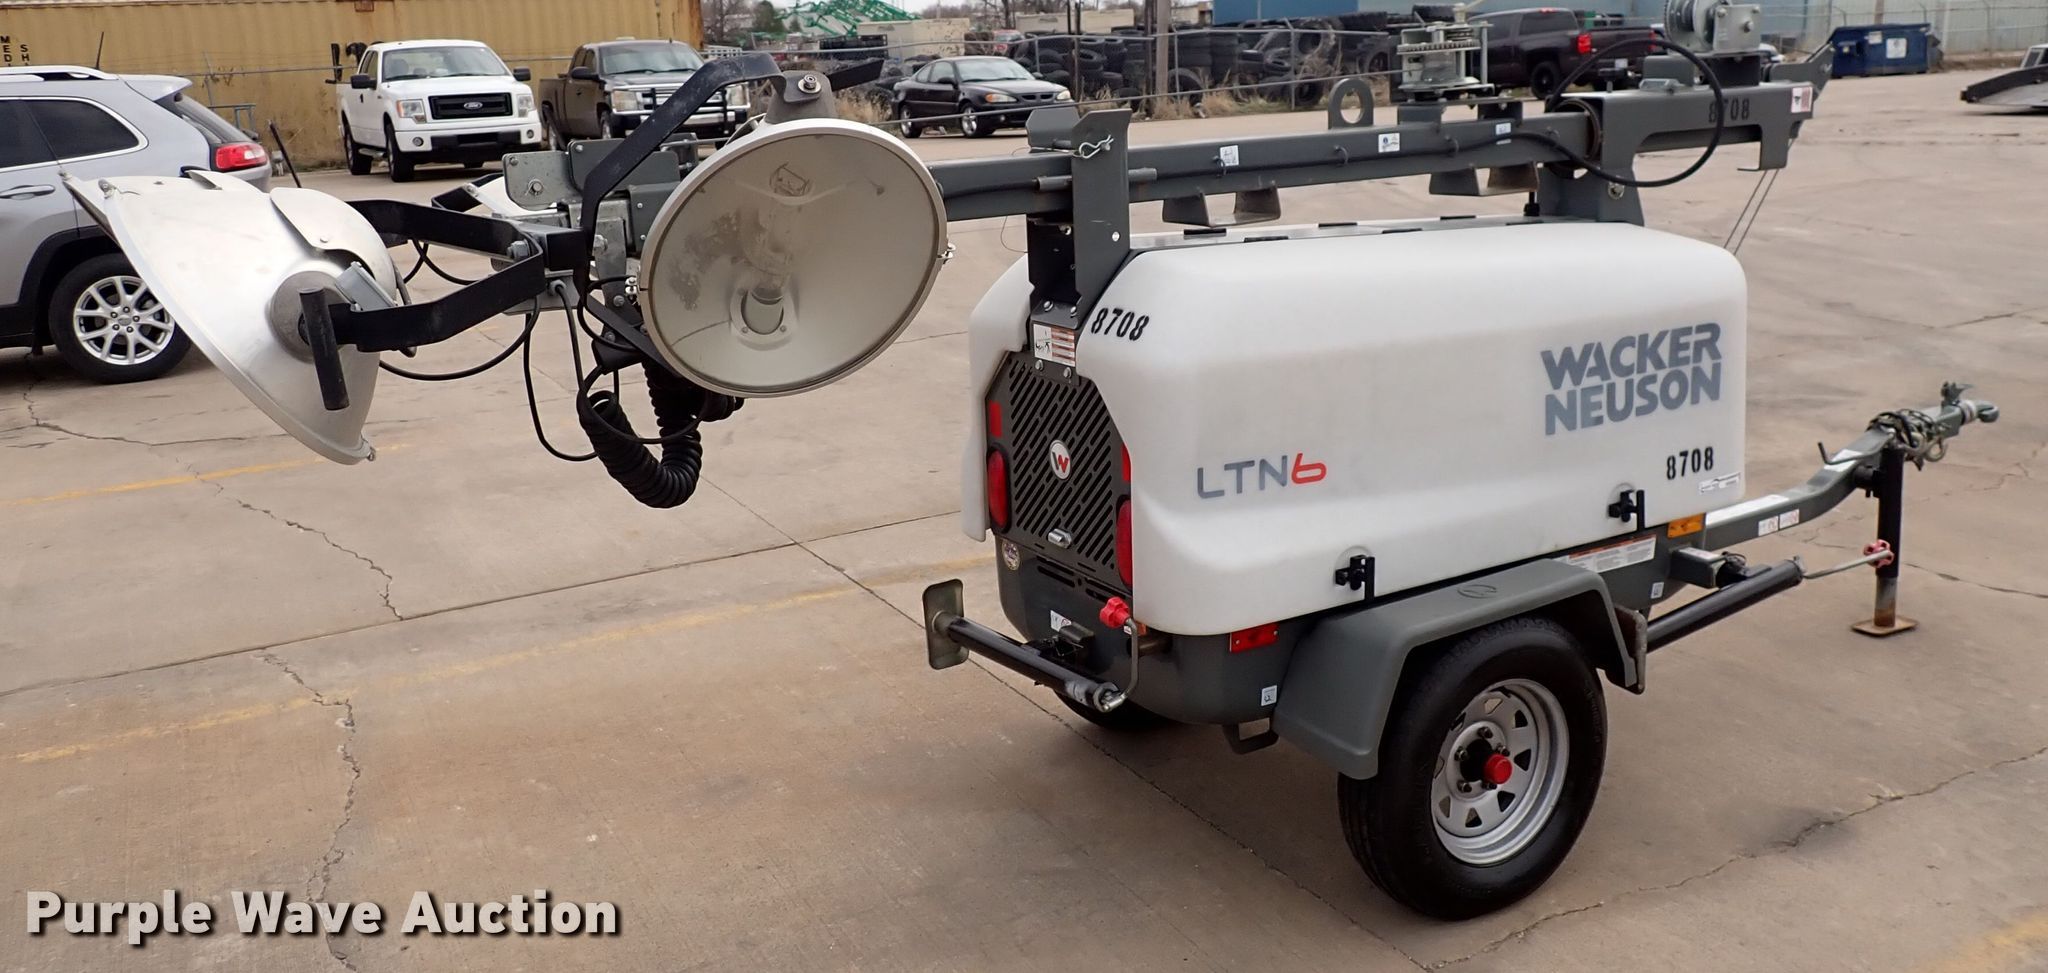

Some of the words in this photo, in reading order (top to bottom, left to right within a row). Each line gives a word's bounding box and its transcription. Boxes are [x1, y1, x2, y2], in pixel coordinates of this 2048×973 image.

[1091, 307, 1150, 341] 8708
[1540, 322, 1722, 390] WACKER
[1545, 362, 1722, 436] NEUSON
[1197, 452, 1327, 499] LTN6
[1666, 446, 1713, 480] 8708
